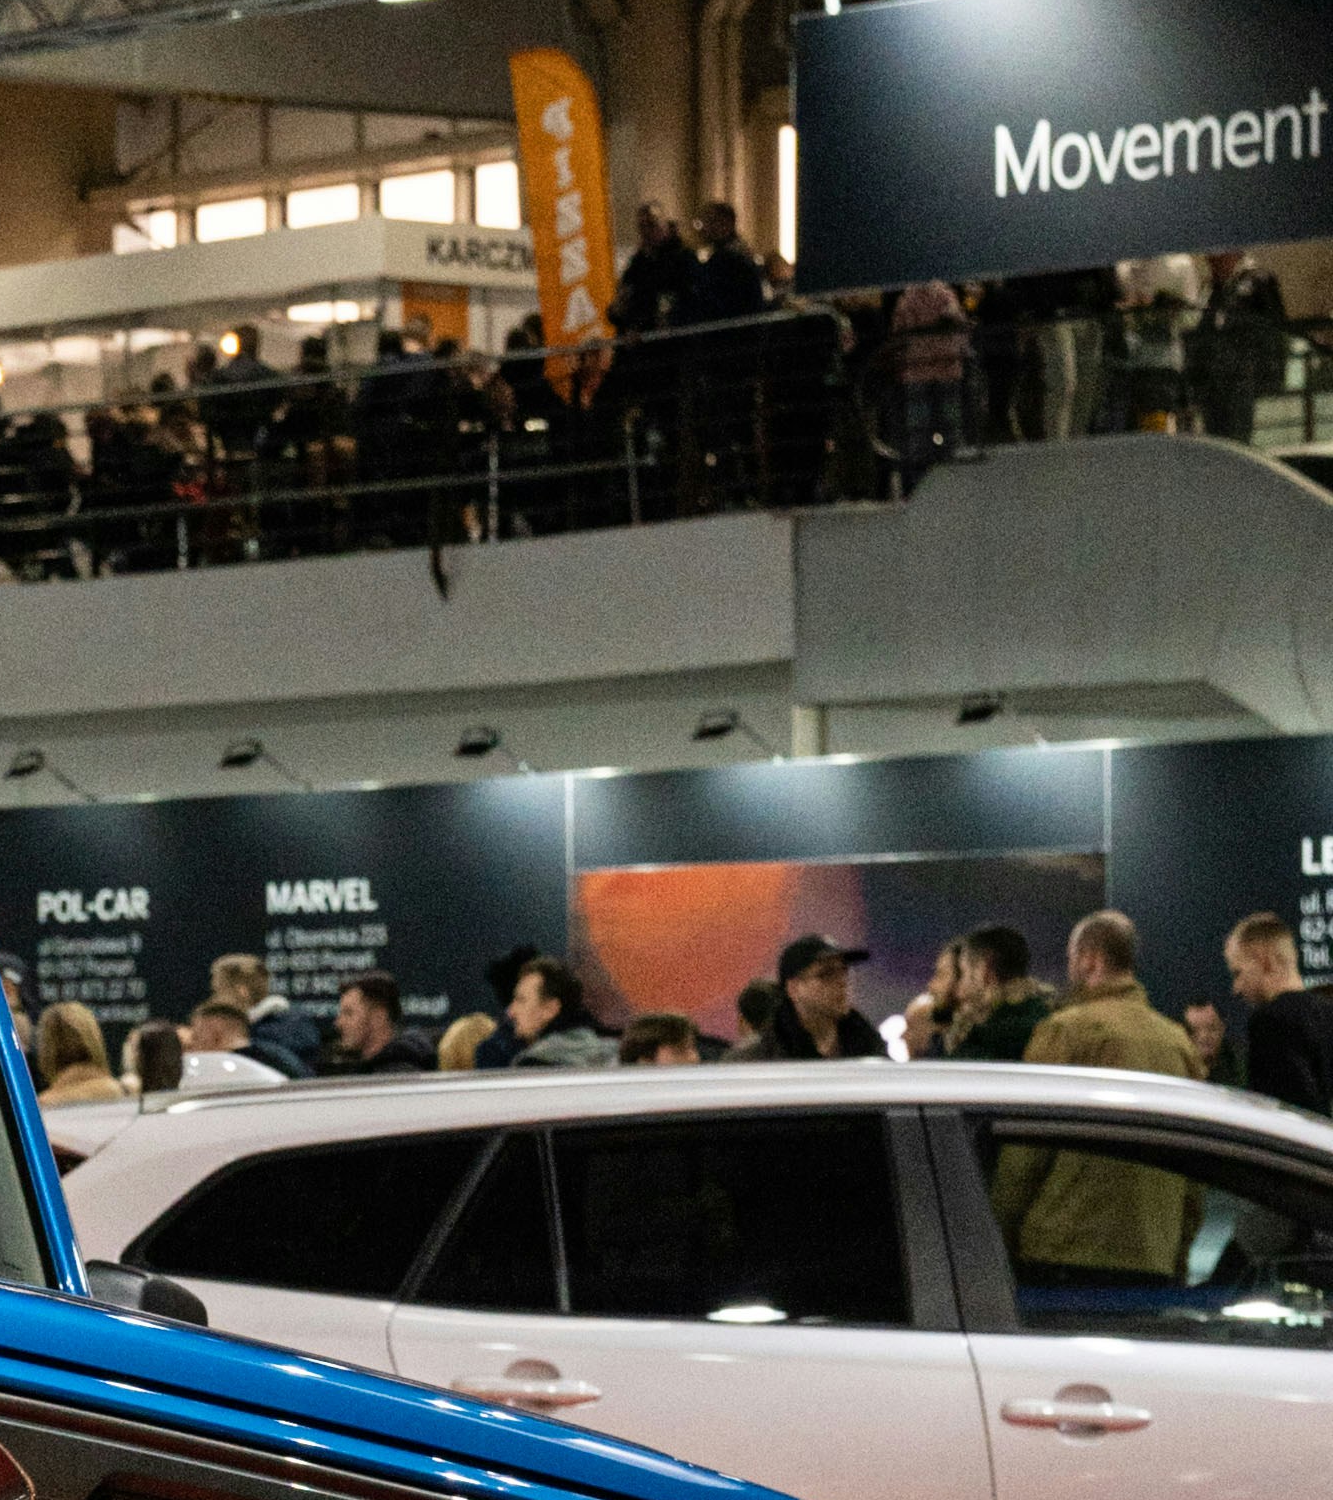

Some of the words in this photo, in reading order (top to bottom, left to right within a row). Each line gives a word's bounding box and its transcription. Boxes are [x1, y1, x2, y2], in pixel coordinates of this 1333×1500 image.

[994, 86, 1330, 198] Movement
[36, 886, 151, 924] POL-CAR
[265, 877, 379, 915] MARVEL
